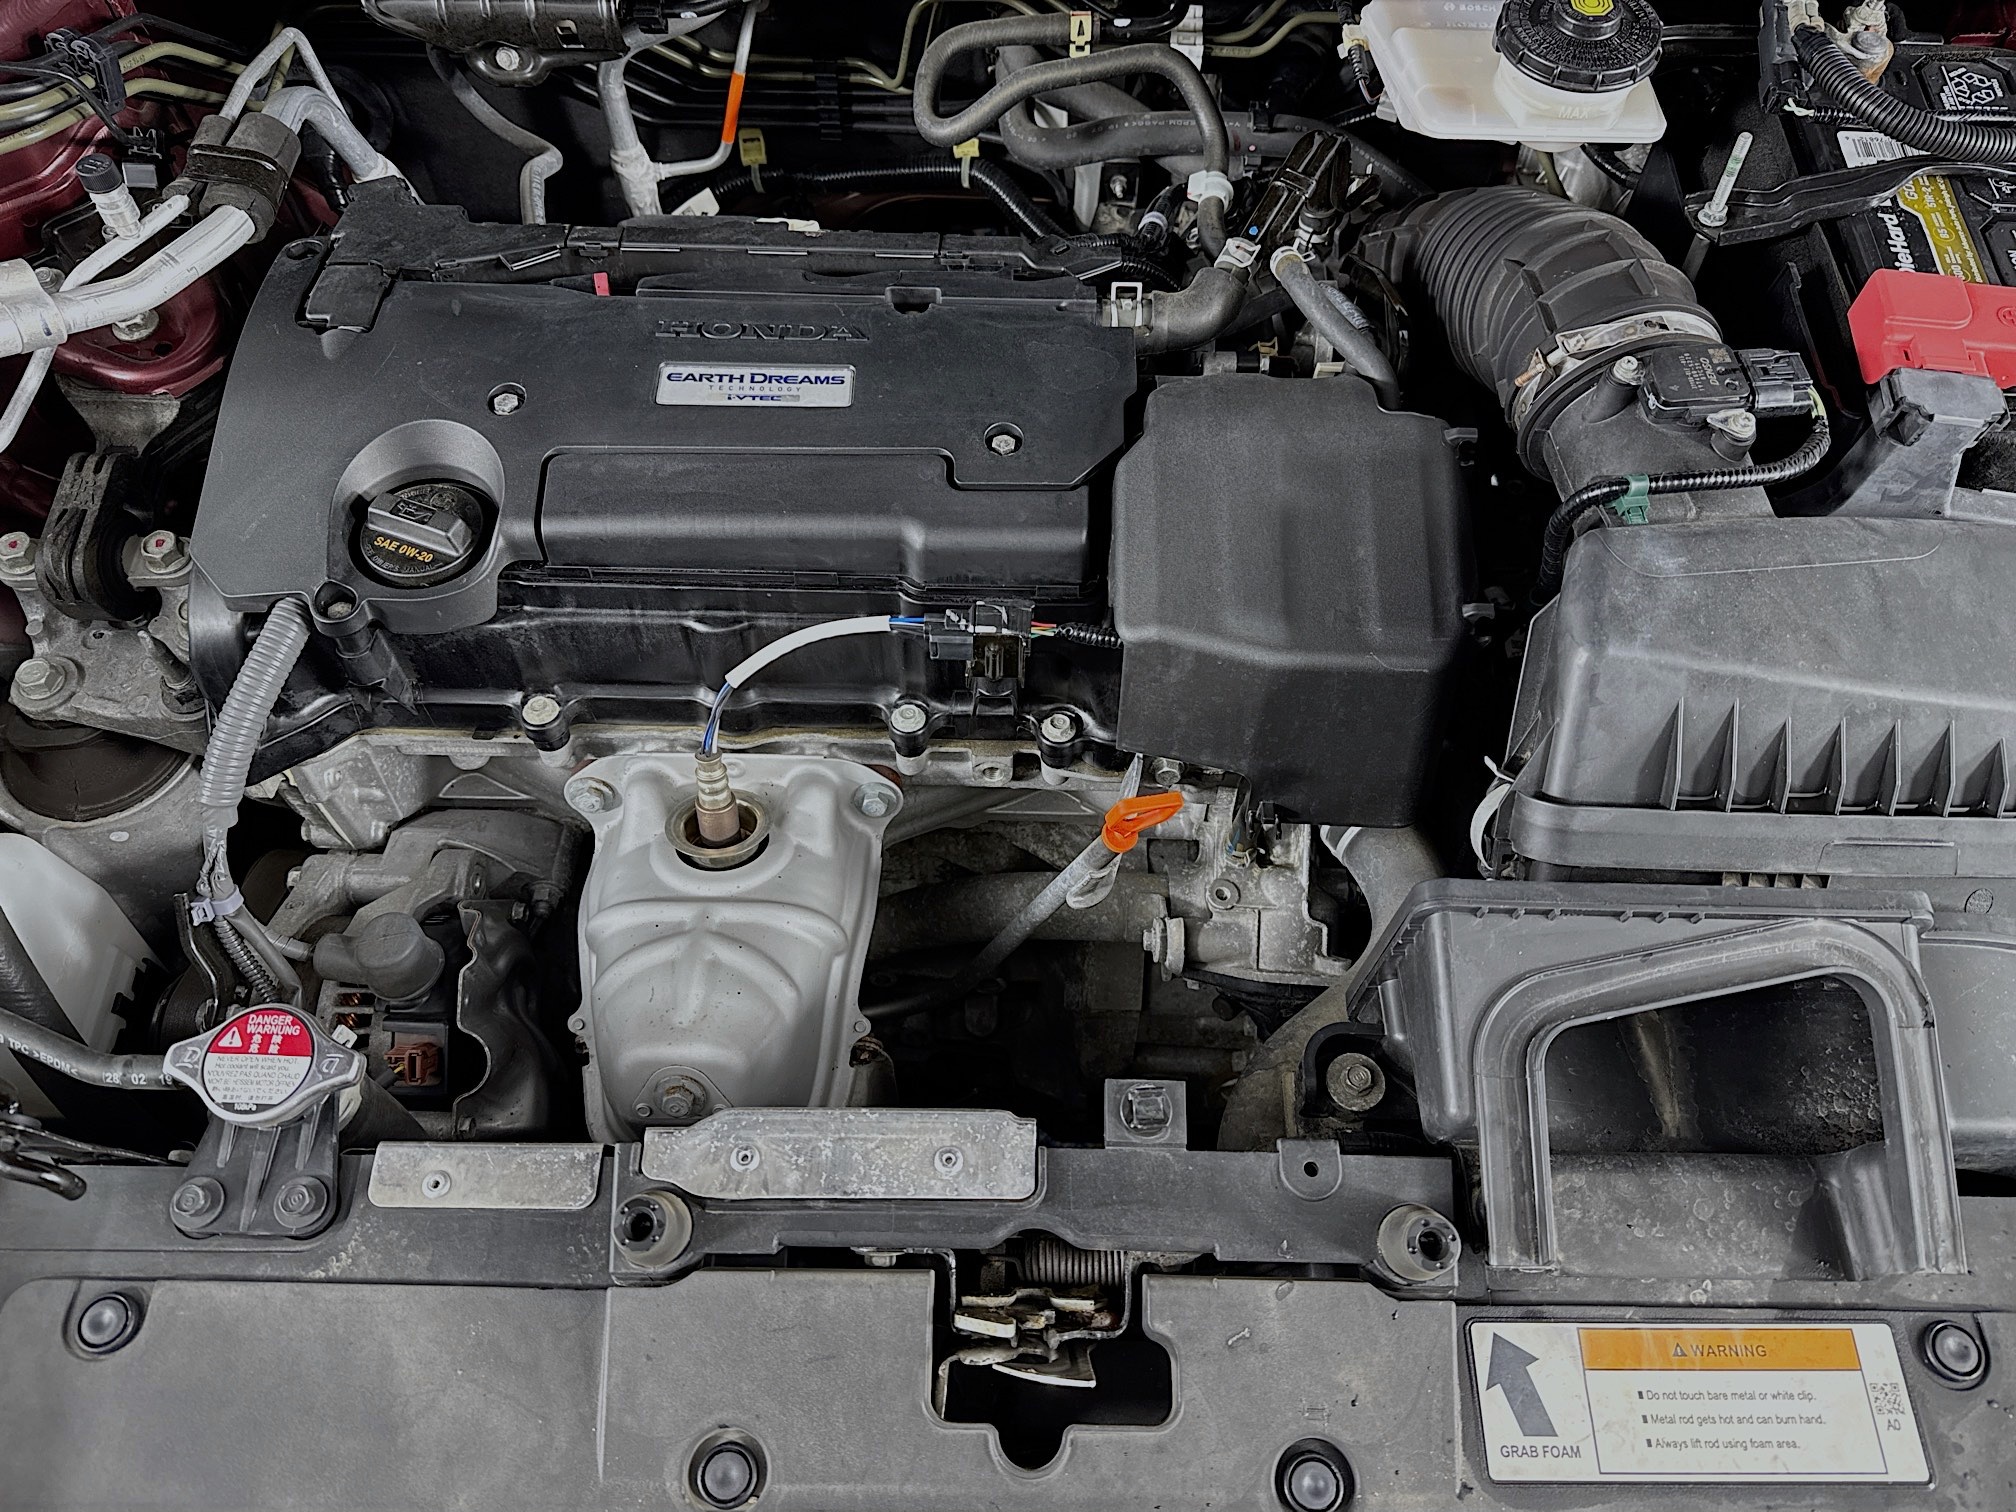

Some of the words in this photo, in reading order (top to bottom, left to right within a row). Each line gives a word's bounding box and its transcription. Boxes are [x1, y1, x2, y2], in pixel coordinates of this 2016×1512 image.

[1459, 4, 1497, 12] BOSCH
[1558, 106, 1592, 119] MAX
[656, 320, 870, 341] HONDA
[1700, 357, 1719, 386] DENSO
[666, 372, 745, 384] EARTH
[750, 373, 845, 385] DREAMS
[374, 536, 400, 552] SAE
[398, 545, 434, 563] 0W-20
[248, 1013, 293, 1026] DANGER
[246, 1023, 301, 1036] WARNUNG
[7, 1037, 30, 1055] TPC
[32, 1050, 79, 1076] >EPDM<
[217, 1055, 239, 1063] NEVER
[261, 1056, 281, 1064] WHEN
[131, 1072, 147, 1085] 02
[158, 1073, 173, 1086] 19
[1690, 1344, 1767, 1357] WARNING
[1646, 1389, 1660, 1401] Do
[1662, 1390, 1677, 1401] not
[1679, 1389, 1705, 1401] touch
[1706, 1389, 1729, 1401] bare
[1730, 1389, 1756, 1401] metal
[1758, 1392, 1768, 1401] or
[1769, 1389, 1795, 1401] white
[1797, 1389, 1817, 1404] clip.
[1650, 1413, 1677, 1425] Metal
[1679, 1413, 1694, 1425] rod
[1696, 1414, 1717, 1427] gets
[1718, 1413, 1735, 1425] hot
[1736, 1413, 1753, 1425] and
[1756, 1416, 1774, 1425] can
[1775, 1413, 1797, 1425] burn
[1798, 1413, 1827, 1425] hand.
[1655, 1438, 1689, 1451] Always
[1690, 1438, 1703, 1449] lift
[1704, 1438, 1720, 1449] rod
[1722, 1439, 1749, 1451] using
[1749, 1438, 1774, 1449] foam
[1776, 1440, 1801, 1449] area.
[1500, 1445, 1539, 1458] GRAB
[1543, 1445, 1582, 1458] FOAM
